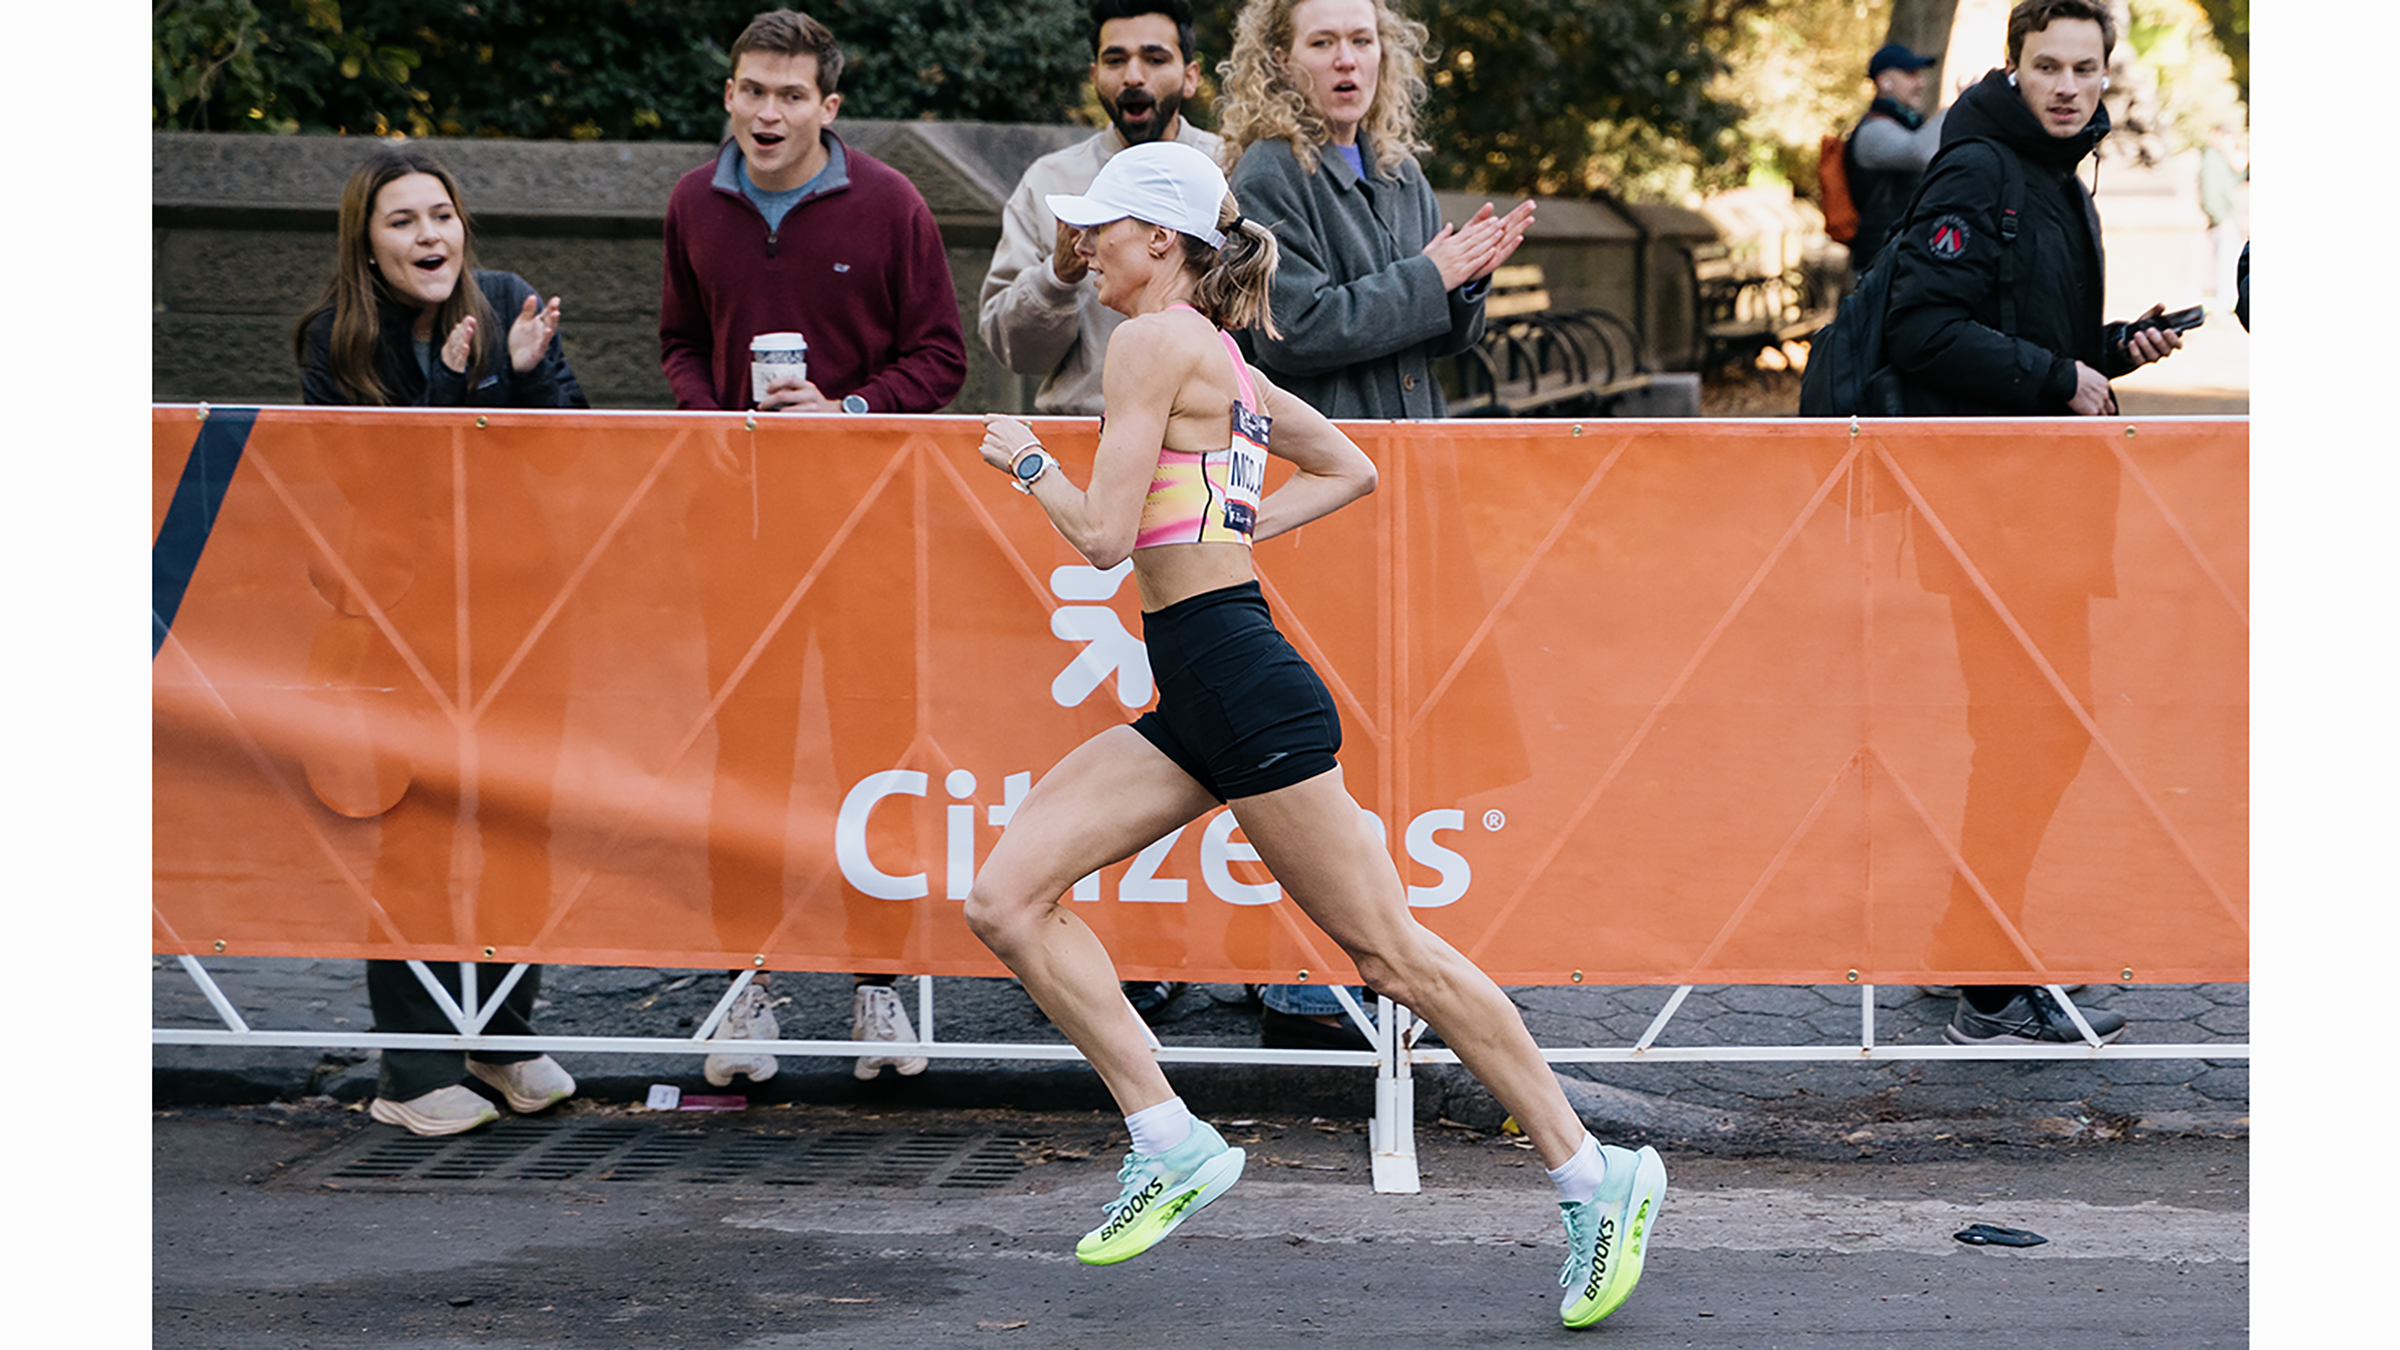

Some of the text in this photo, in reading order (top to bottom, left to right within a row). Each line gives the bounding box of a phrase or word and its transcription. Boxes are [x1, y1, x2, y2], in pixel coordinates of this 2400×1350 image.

[834, 769, 1506, 907] Cizes®
[1100, 1176, 1164, 1242] BROOKS
[1583, 1215, 1615, 1301] BROOKS
